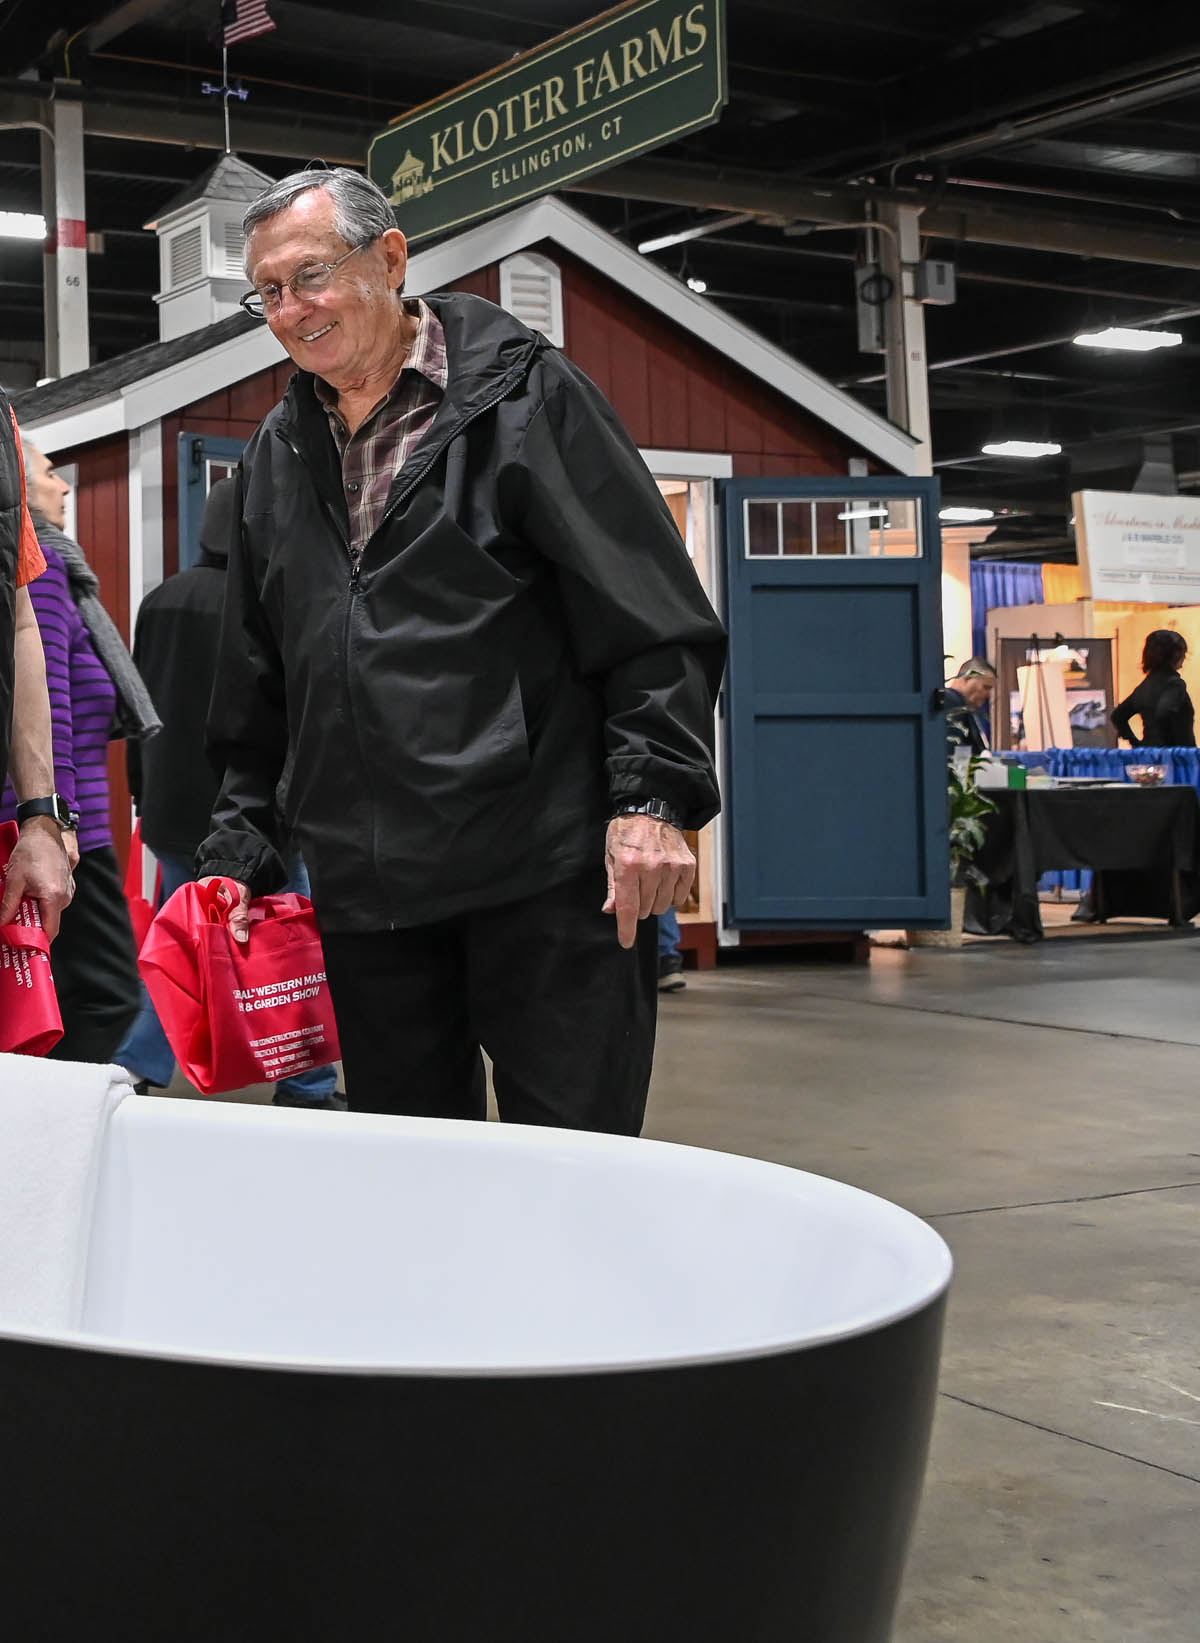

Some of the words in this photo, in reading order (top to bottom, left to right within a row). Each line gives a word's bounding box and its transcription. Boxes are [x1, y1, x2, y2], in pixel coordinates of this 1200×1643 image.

[430, 76, 568, 172] KLOTER
[573, 4, 707, 108] FARMS
[491, 132, 592, 189] ELLINGTON,
[601, 116, 622, 141] CT
[65, 276, 80, 287] 66
[245, 1002, 254, 1012] &
[254, 994, 291, 1010] GARDEN
[292, 986, 320, 1002] SHOW
[255, 977, 302, 997] WESTERN
